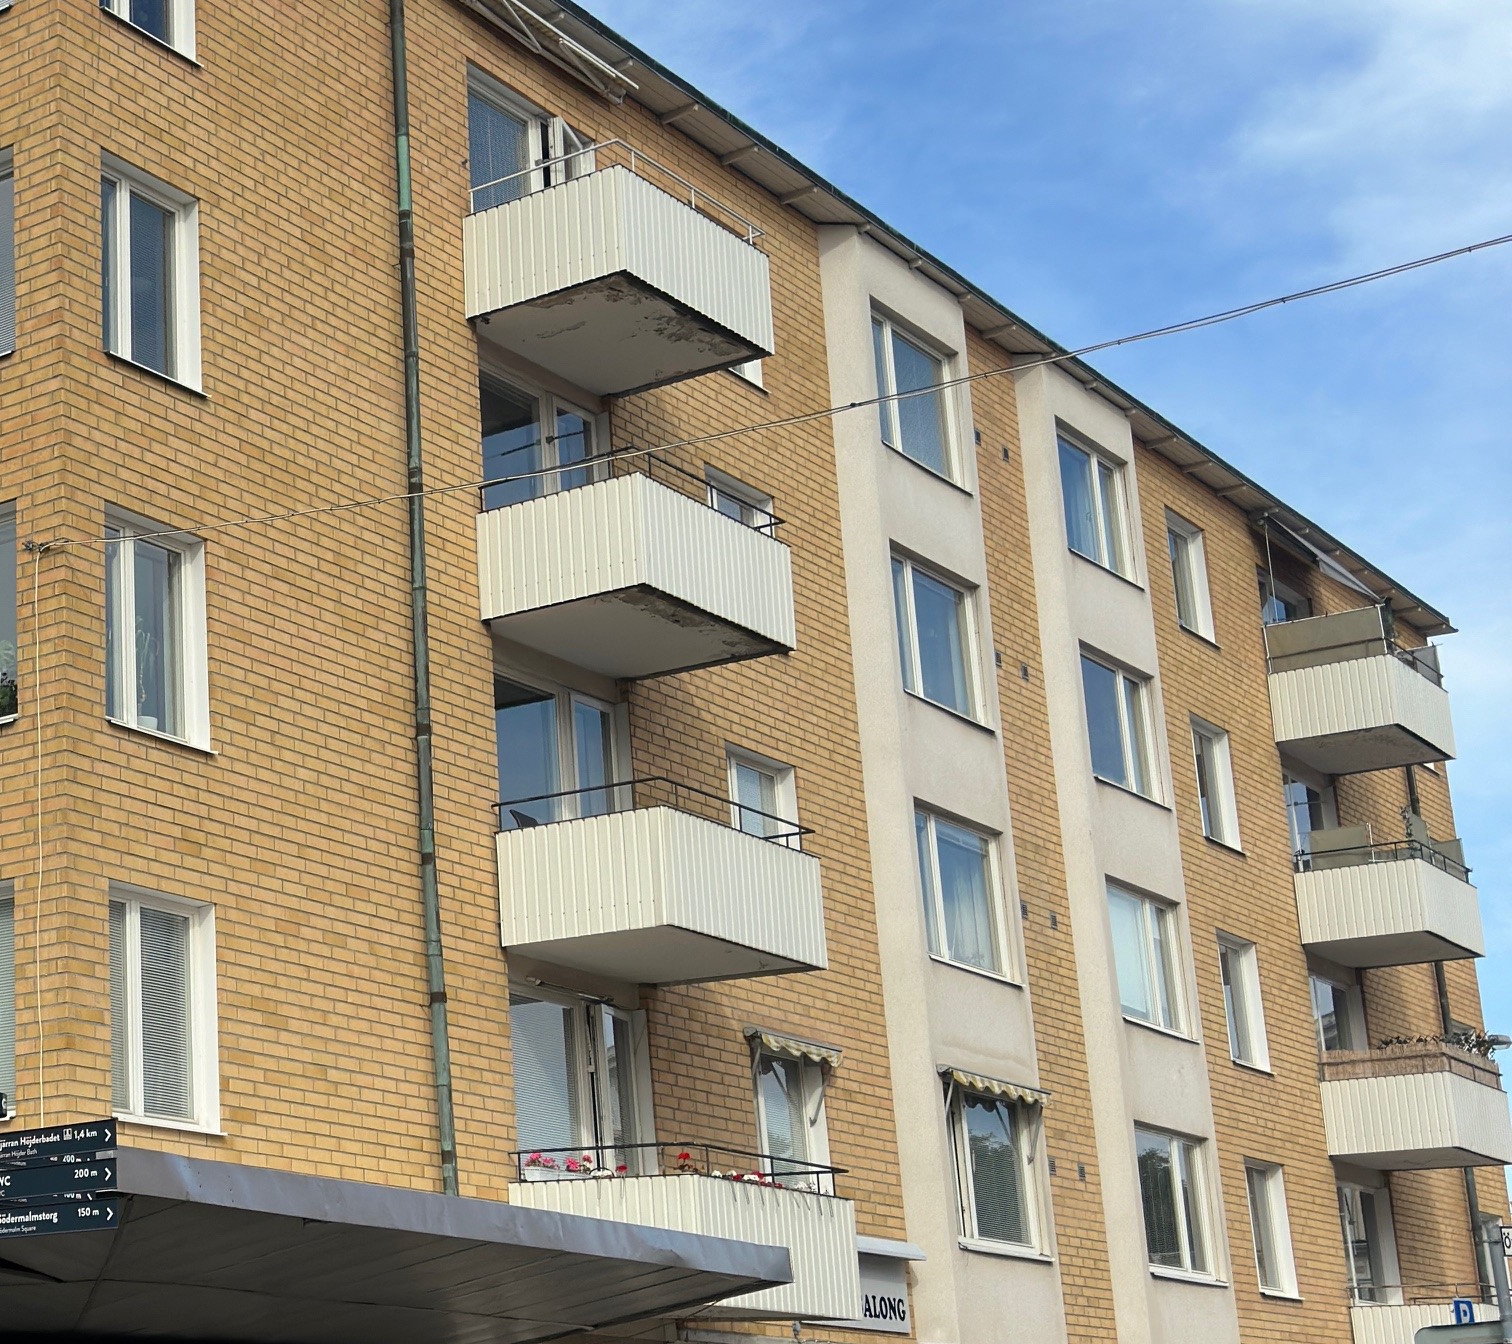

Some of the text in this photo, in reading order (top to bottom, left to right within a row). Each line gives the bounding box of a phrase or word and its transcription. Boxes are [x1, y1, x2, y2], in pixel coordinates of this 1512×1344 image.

[19, 1133, 60, 1146] Höjderbadet
[74, 1129, 85, 1141] 1,4
[86, 1129, 98, 1138] km
[74, 1168, 89, 1179] 200
[78, 1207, 90, 1217] 150
[862, 1294, 906, 1322] ALONG
